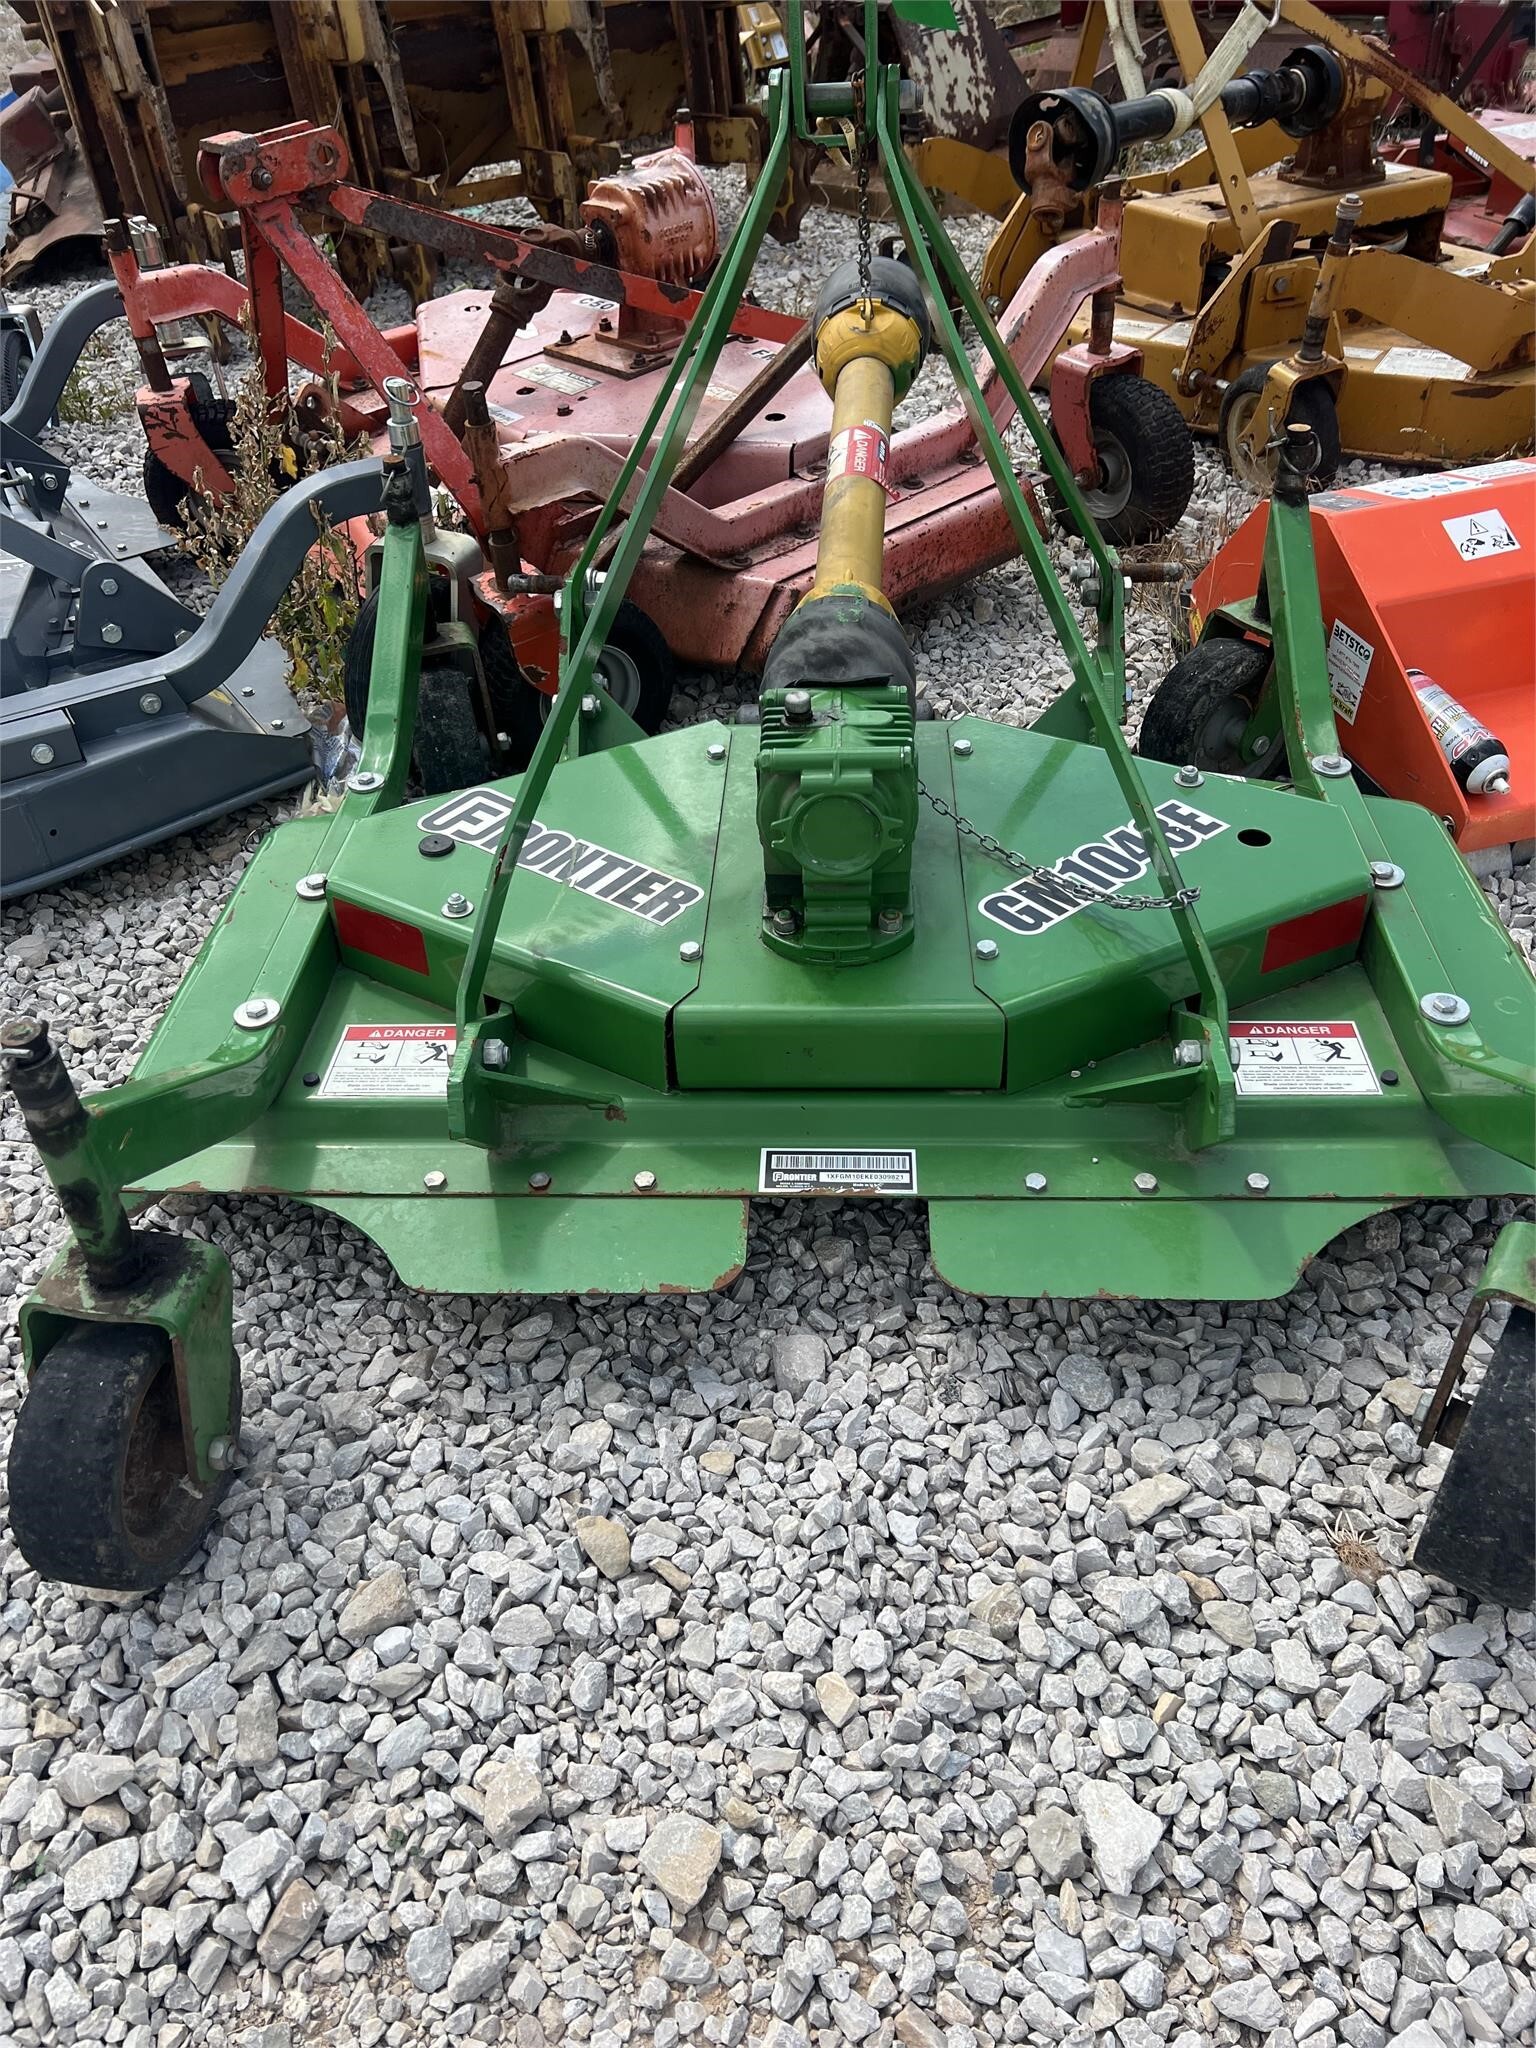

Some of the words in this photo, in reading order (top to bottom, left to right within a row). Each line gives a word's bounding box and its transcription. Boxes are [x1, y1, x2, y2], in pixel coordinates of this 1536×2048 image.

[853, 439, 868, 473] DANGER
[1333, 624, 1371, 661] BETSTCO
[383, 1029, 446, 1037] DANGER
[1263, 1026, 1331, 1035] DANGER
[772, 1171, 818, 1182] FRONTIER
